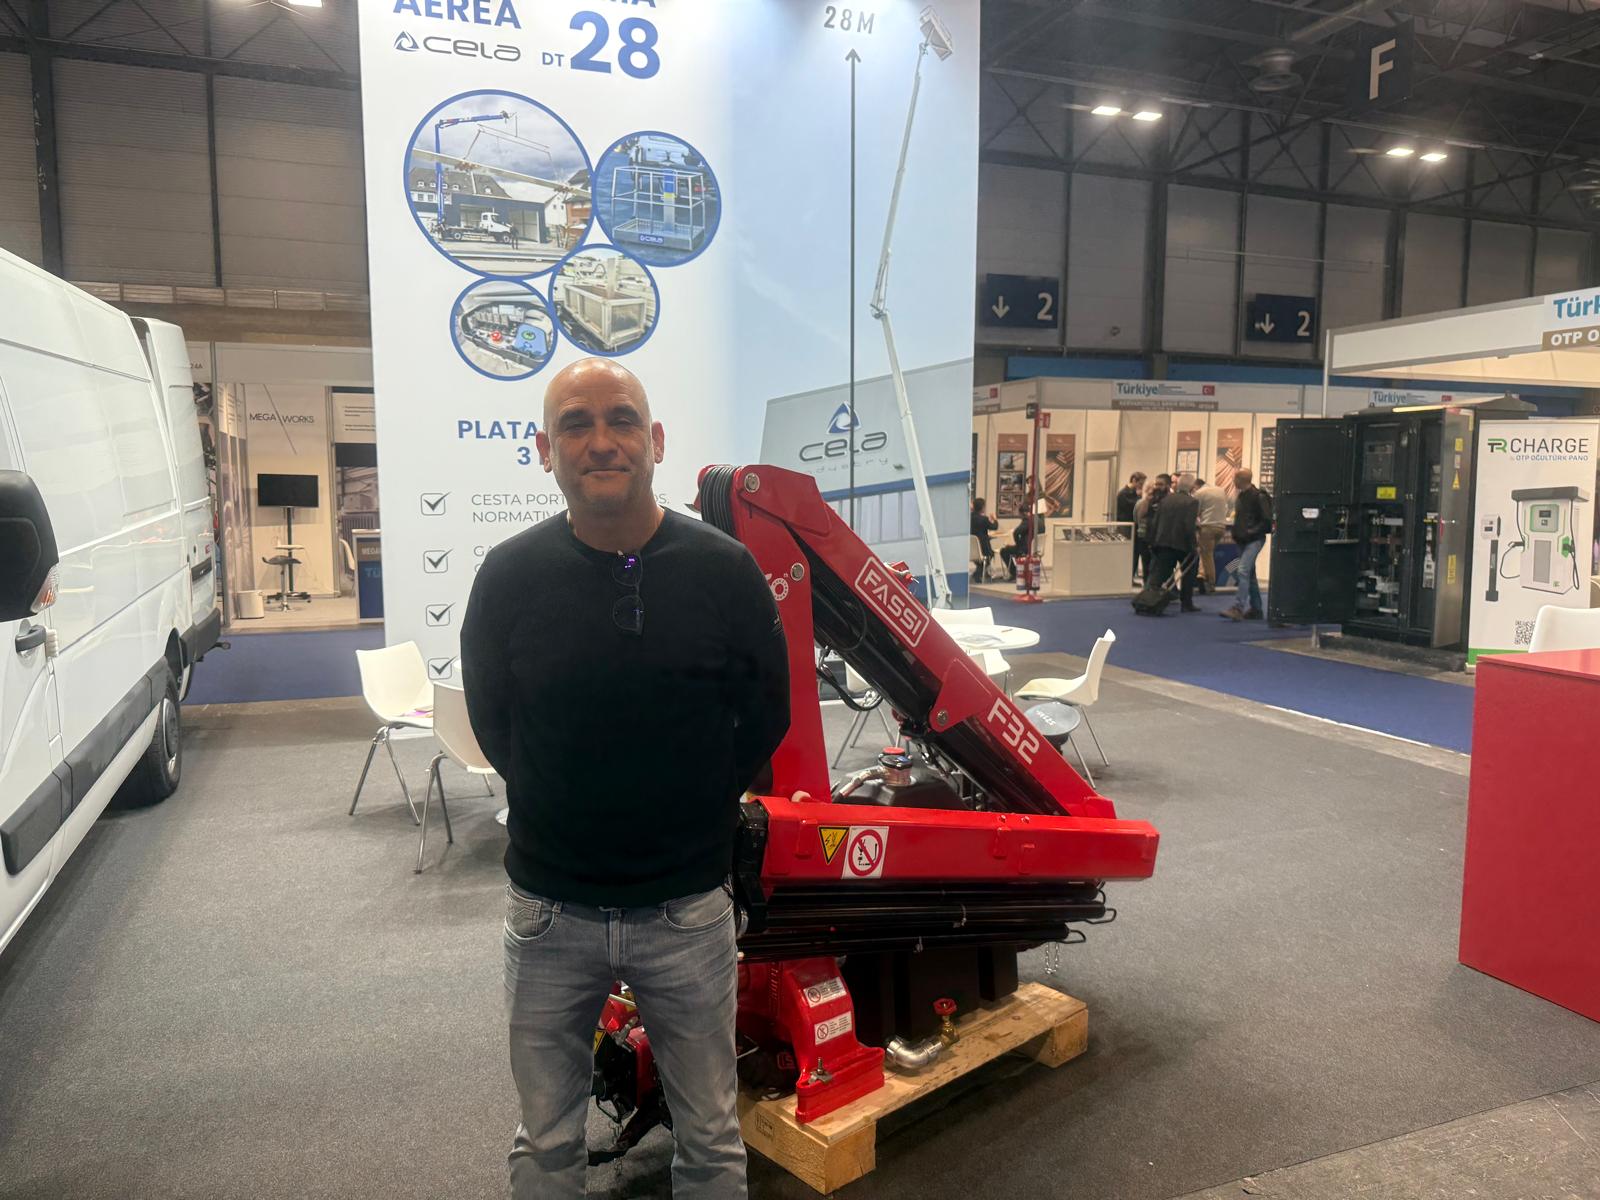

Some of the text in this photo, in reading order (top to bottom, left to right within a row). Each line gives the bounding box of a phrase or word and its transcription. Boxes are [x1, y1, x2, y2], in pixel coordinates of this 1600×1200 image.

[423, 36, 521, 62] cela
[541, 10, 661, 80] DT 28
[1369, 38, 1396, 100] F
[1036, 292, 1054, 321] 2
[1297, 311, 1310, 337] 2
[1551, 331, 1582, 346] OTP
[1117, 382, 1158, 397] Türkiye
[1373, 390, 1407, 403] Türkiye
[249, 413, 315, 424] MEGA WORKS
[458, 420, 537, 440] PLATA
[1510, 438, 1589, 453] CHARGE
[517, 446, 531, 466] 3
[471, 494, 524, 506] CESTA
[526, 494, 565, 505] PORT
[472, 510, 556, 523] NORMATIV
[864, 568, 922, 636] FASSI
[987, 697, 1040, 765] F32
